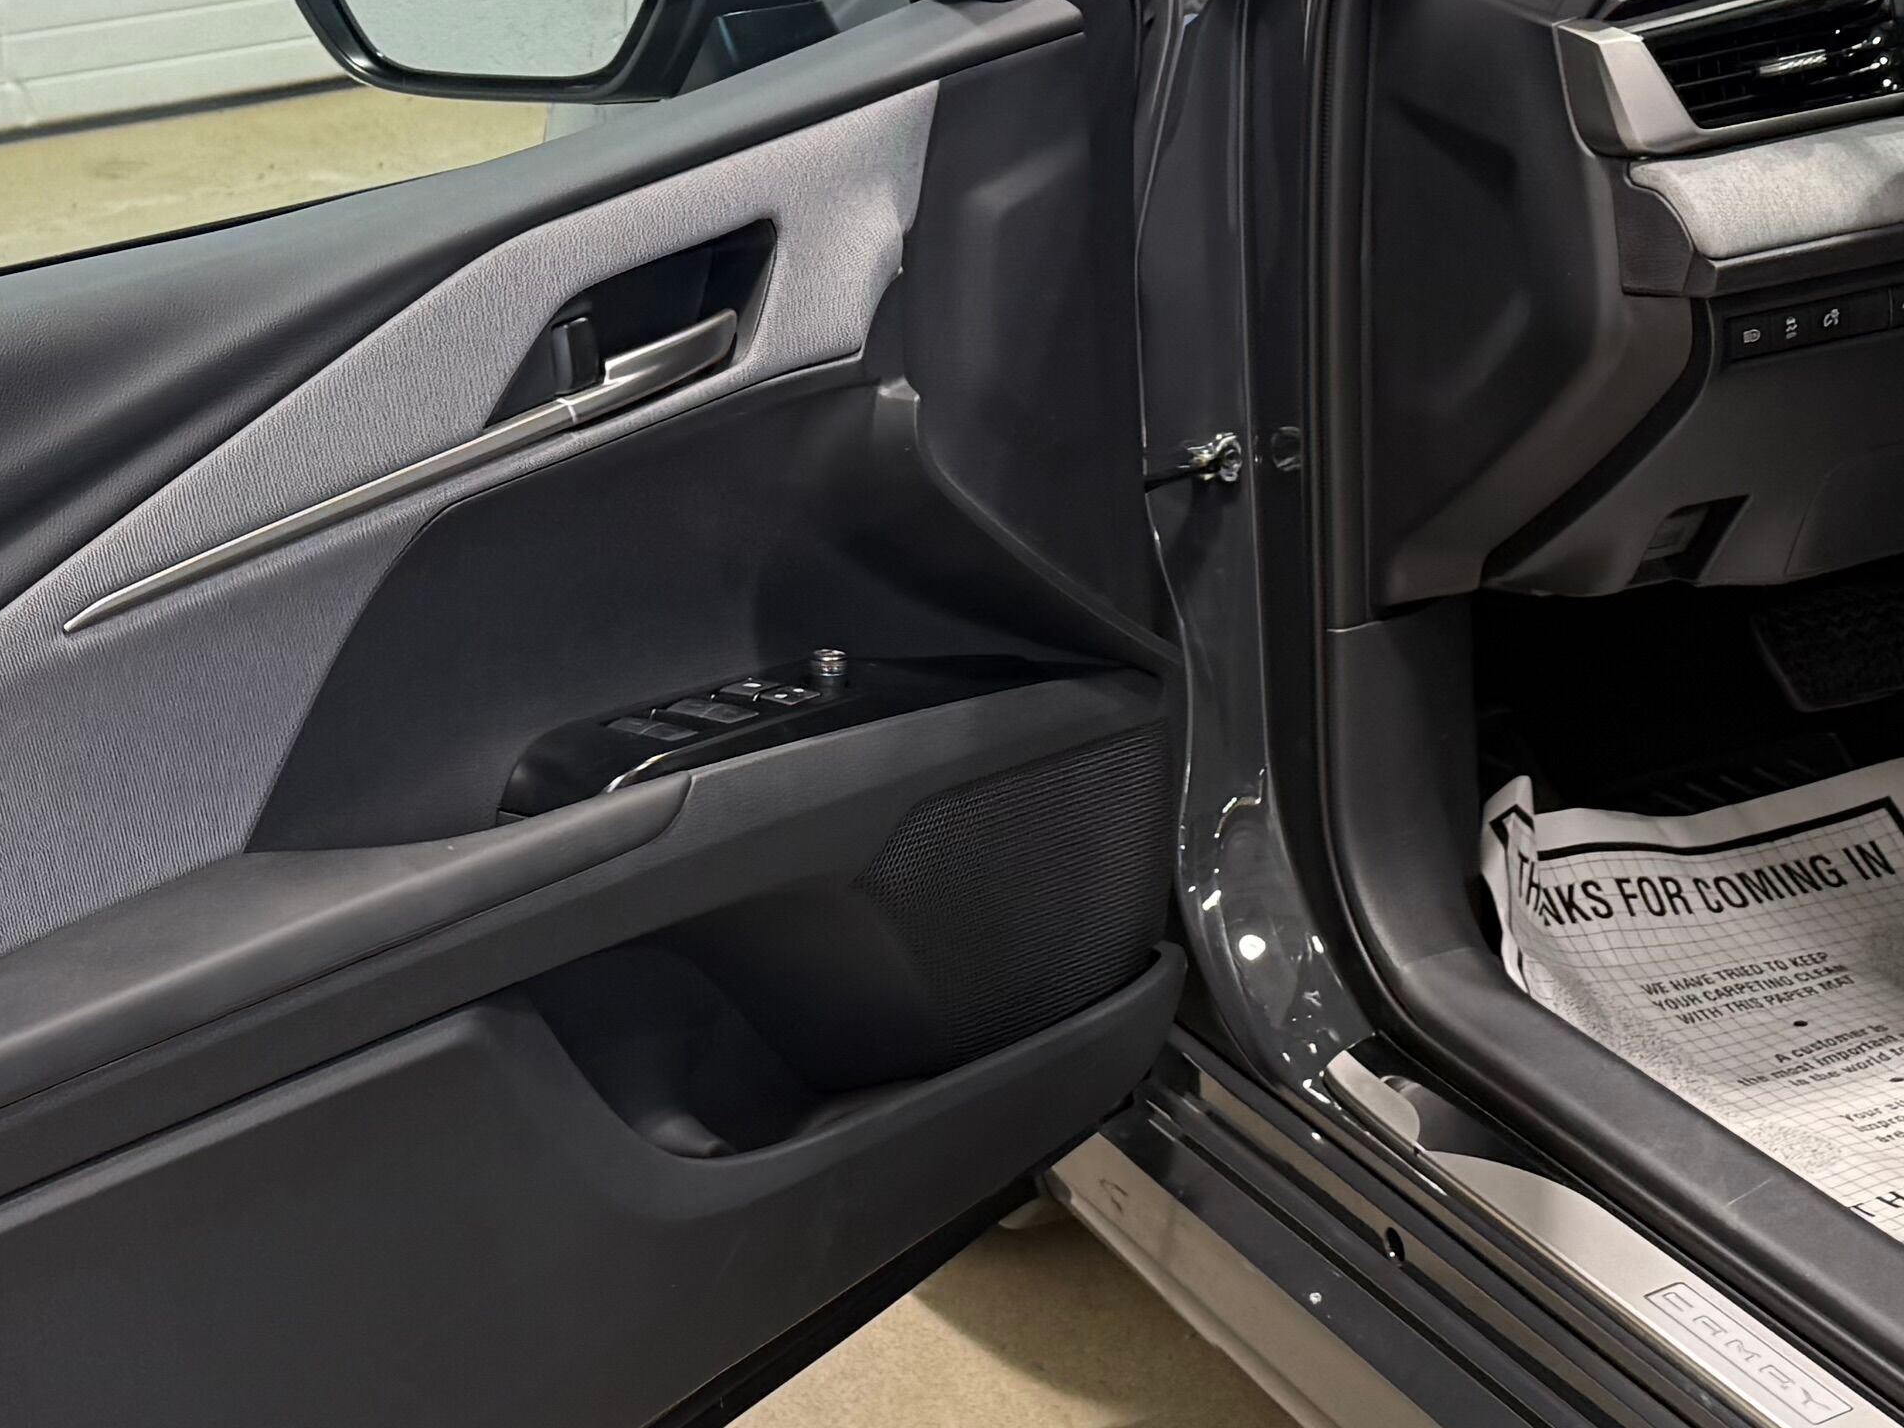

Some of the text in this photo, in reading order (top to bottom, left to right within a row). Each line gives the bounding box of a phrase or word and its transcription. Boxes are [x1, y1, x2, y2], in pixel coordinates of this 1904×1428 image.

[1614, 876, 1694, 917] FOR
[1692, 854, 1848, 914] COMING
[1842, 840, 1896, 881] IN
[1640, 951, 1829, 997] WE HAVE TRIED TO KEEP
[1652, 963, 1849, 1013] YOUR CARPETING CLEAN
[1676, 974, 1856, 1026] WITH THIS PAPER MAT
[1737, 1073, 1770, 1087] the
[1770, 1061, 1818, 1080] most
[1814, 1033, 1899, 1068] important
[1774, 1023, 1890, 1064] A customer is
[1789, 1077, 1811, 1088] in
[1809, 1070, 1842, 1083] the
[1840, 1052, 1892, 1074] world
[1839, 1106, 1883, 1123] Your
[1662, 1292, 1833, 1412] CAMRY
